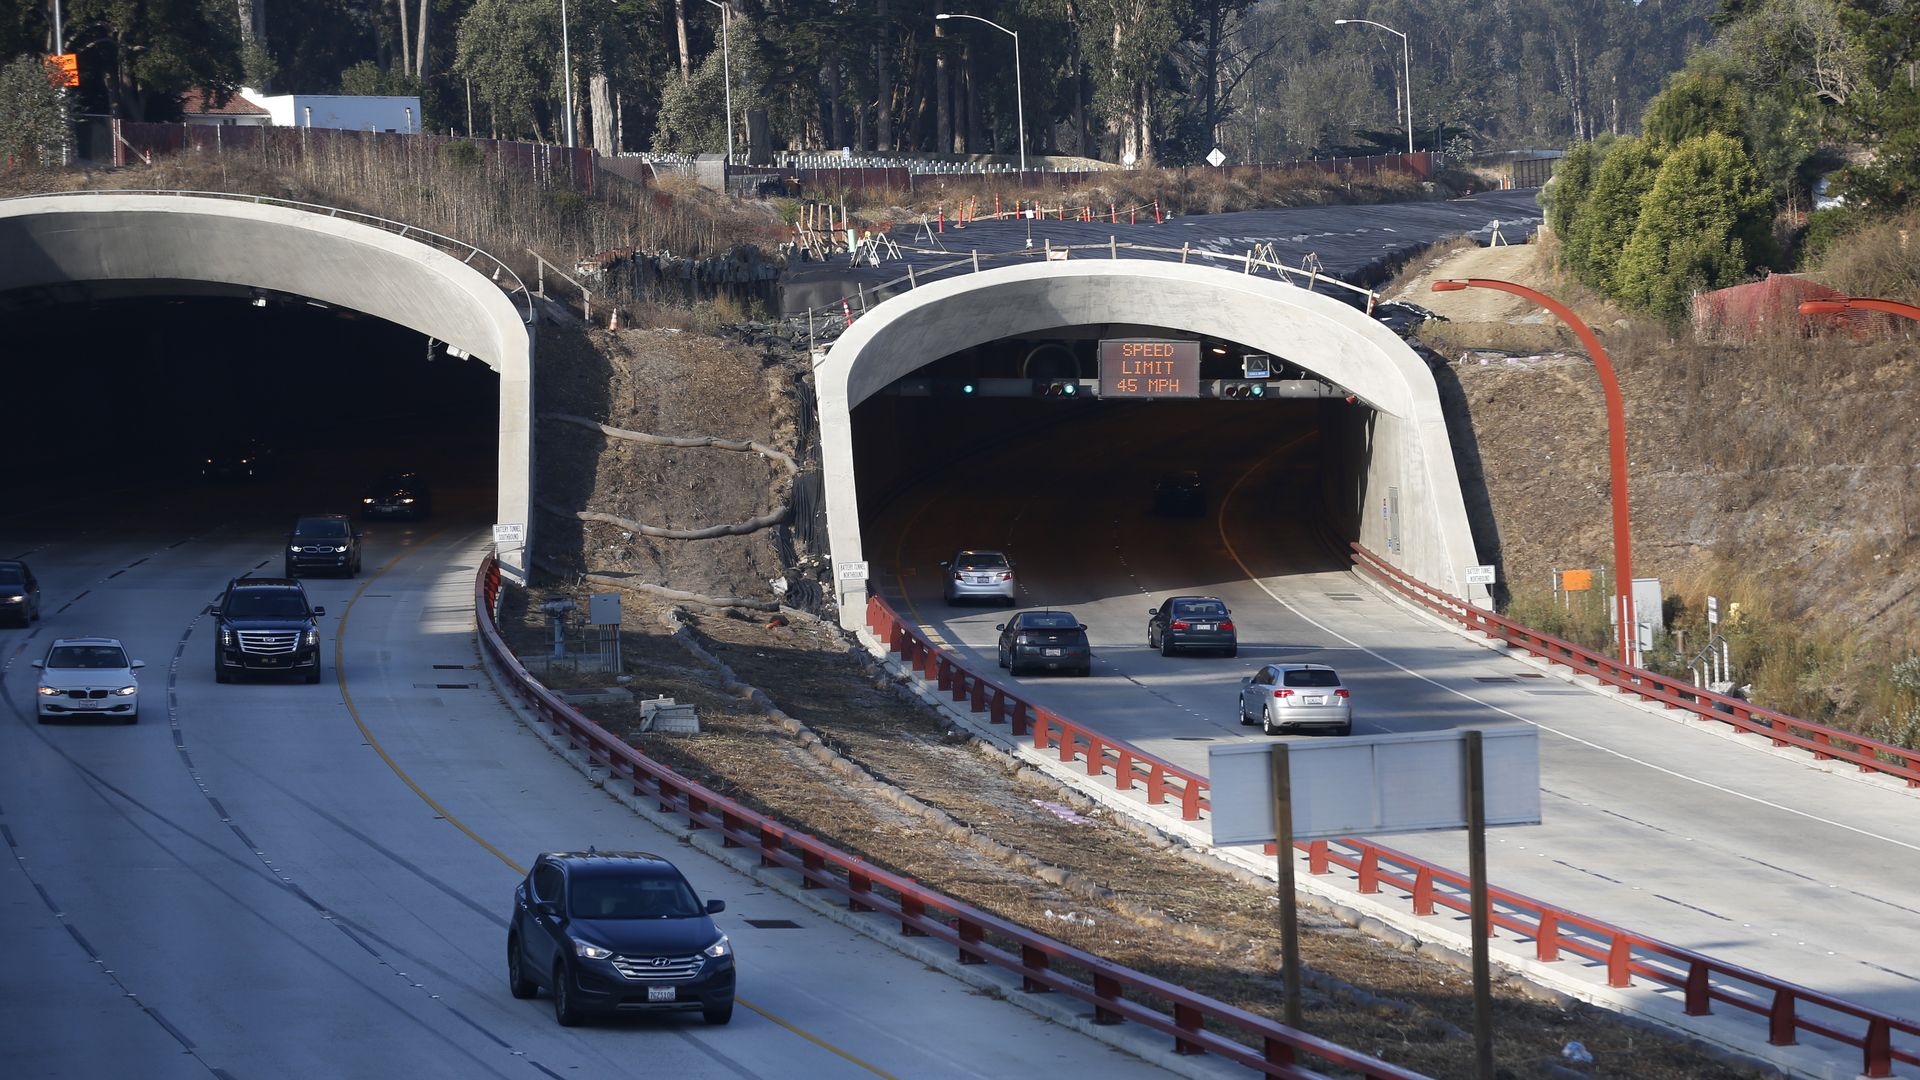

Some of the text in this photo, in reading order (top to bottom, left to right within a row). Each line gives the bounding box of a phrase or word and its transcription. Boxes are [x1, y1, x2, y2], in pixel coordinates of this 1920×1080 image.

[1122, 343, 1174, 357] SPEED
[1121, 361, 1174, 374] LIMIT
[1117, 378, 1179, 392] 45 MPH
